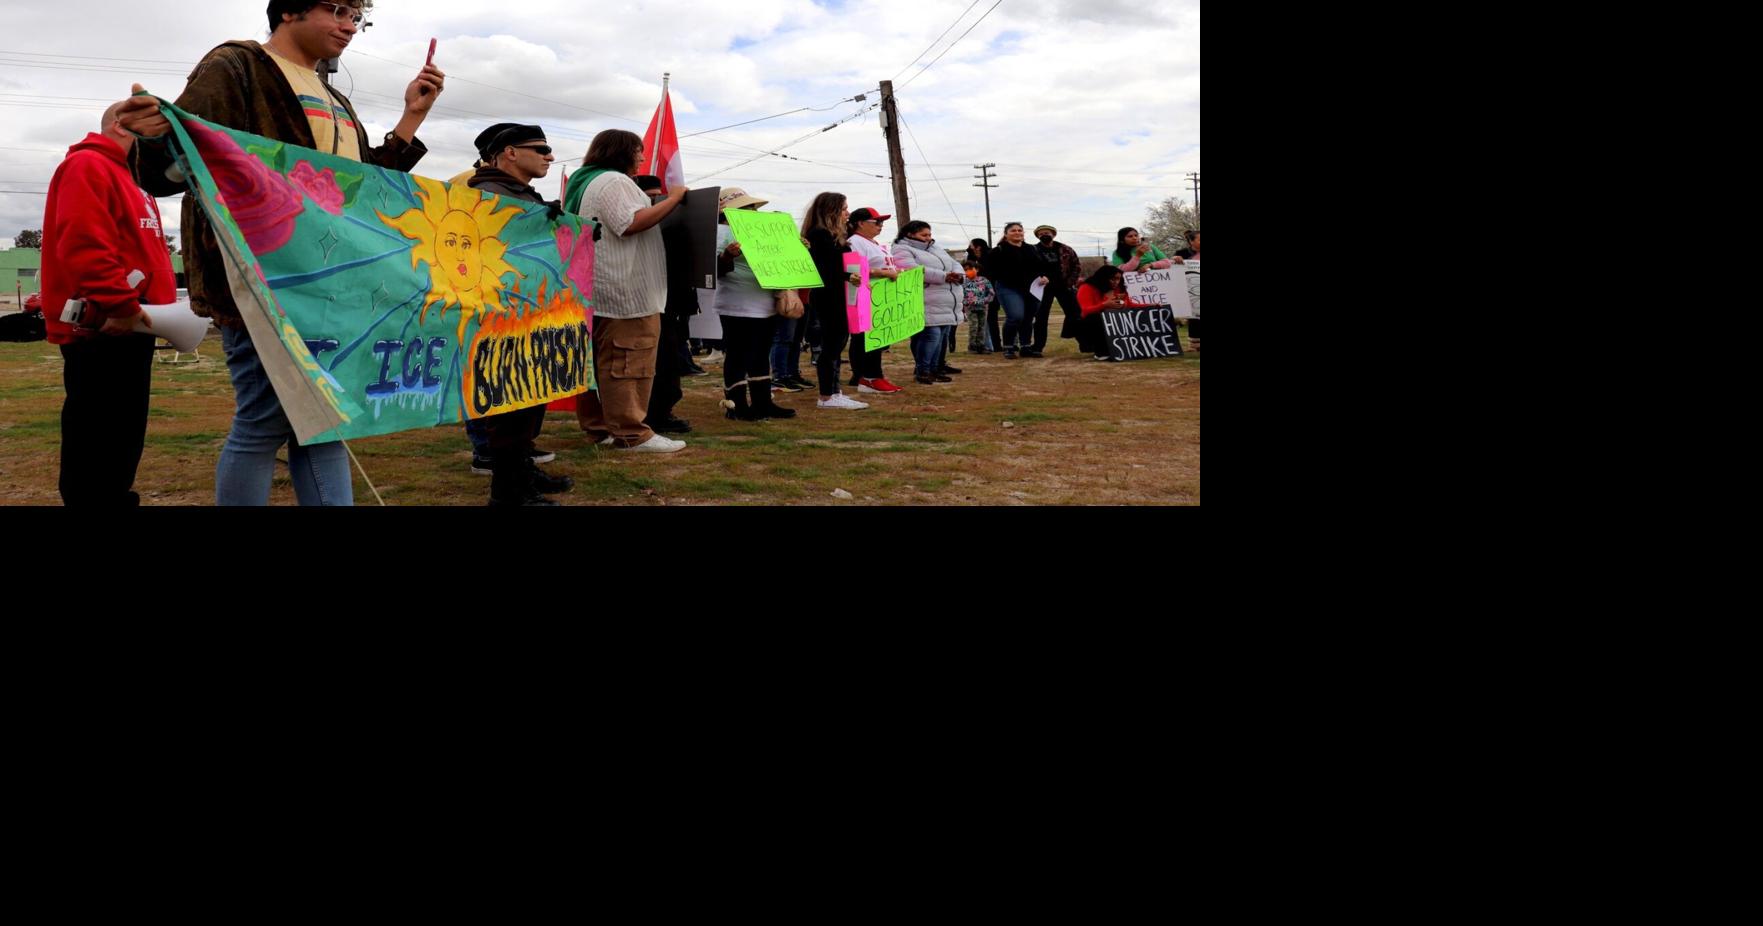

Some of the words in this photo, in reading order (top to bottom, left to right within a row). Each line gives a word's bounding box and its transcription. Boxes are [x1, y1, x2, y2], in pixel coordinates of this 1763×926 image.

[1125, 271, 1171, 285] EEDOM
[1140, 285, 1159, 293] AND
[1131, 292, 1168, 305] STICE
[872, 299, 915, 329] GOLDEN
[1101, 308, 1173, 337] HUNGER
[1112, 334, 1180, 361] STRIKE
[365, 336, 447, 395] ICE
